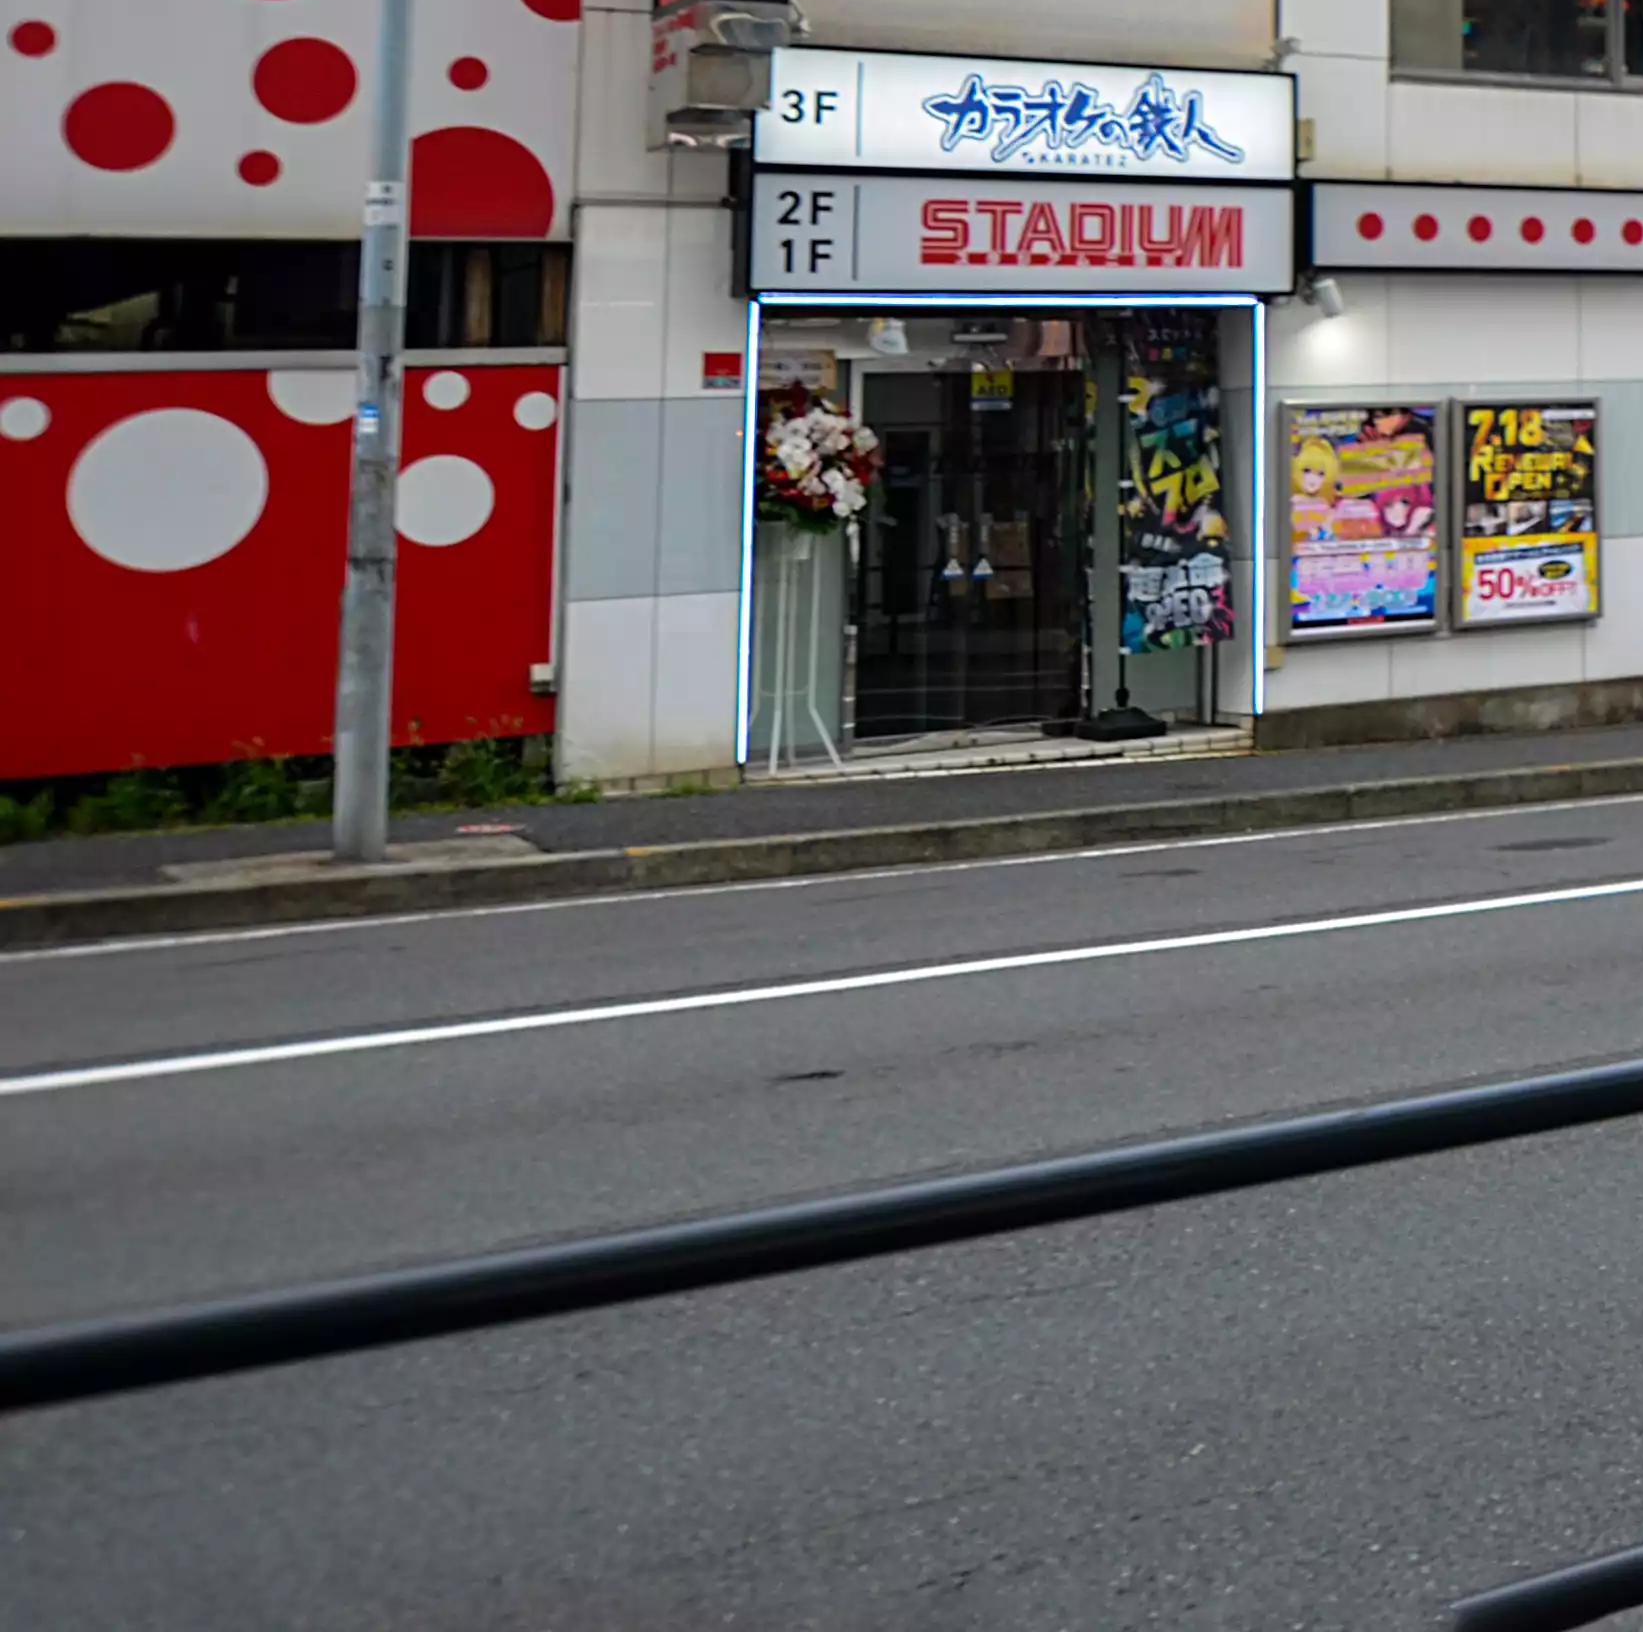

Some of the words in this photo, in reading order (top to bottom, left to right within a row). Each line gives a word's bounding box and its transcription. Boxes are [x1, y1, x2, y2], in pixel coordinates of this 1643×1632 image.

[780, 90, 840, 125] 3F
[922, 72, 1246, 165] カラオケの鉄人
[777, 190, 836, 226] 2F
[919, 199, 1244, 269] STADIUM
[778, 238, 836, 275] 1F
